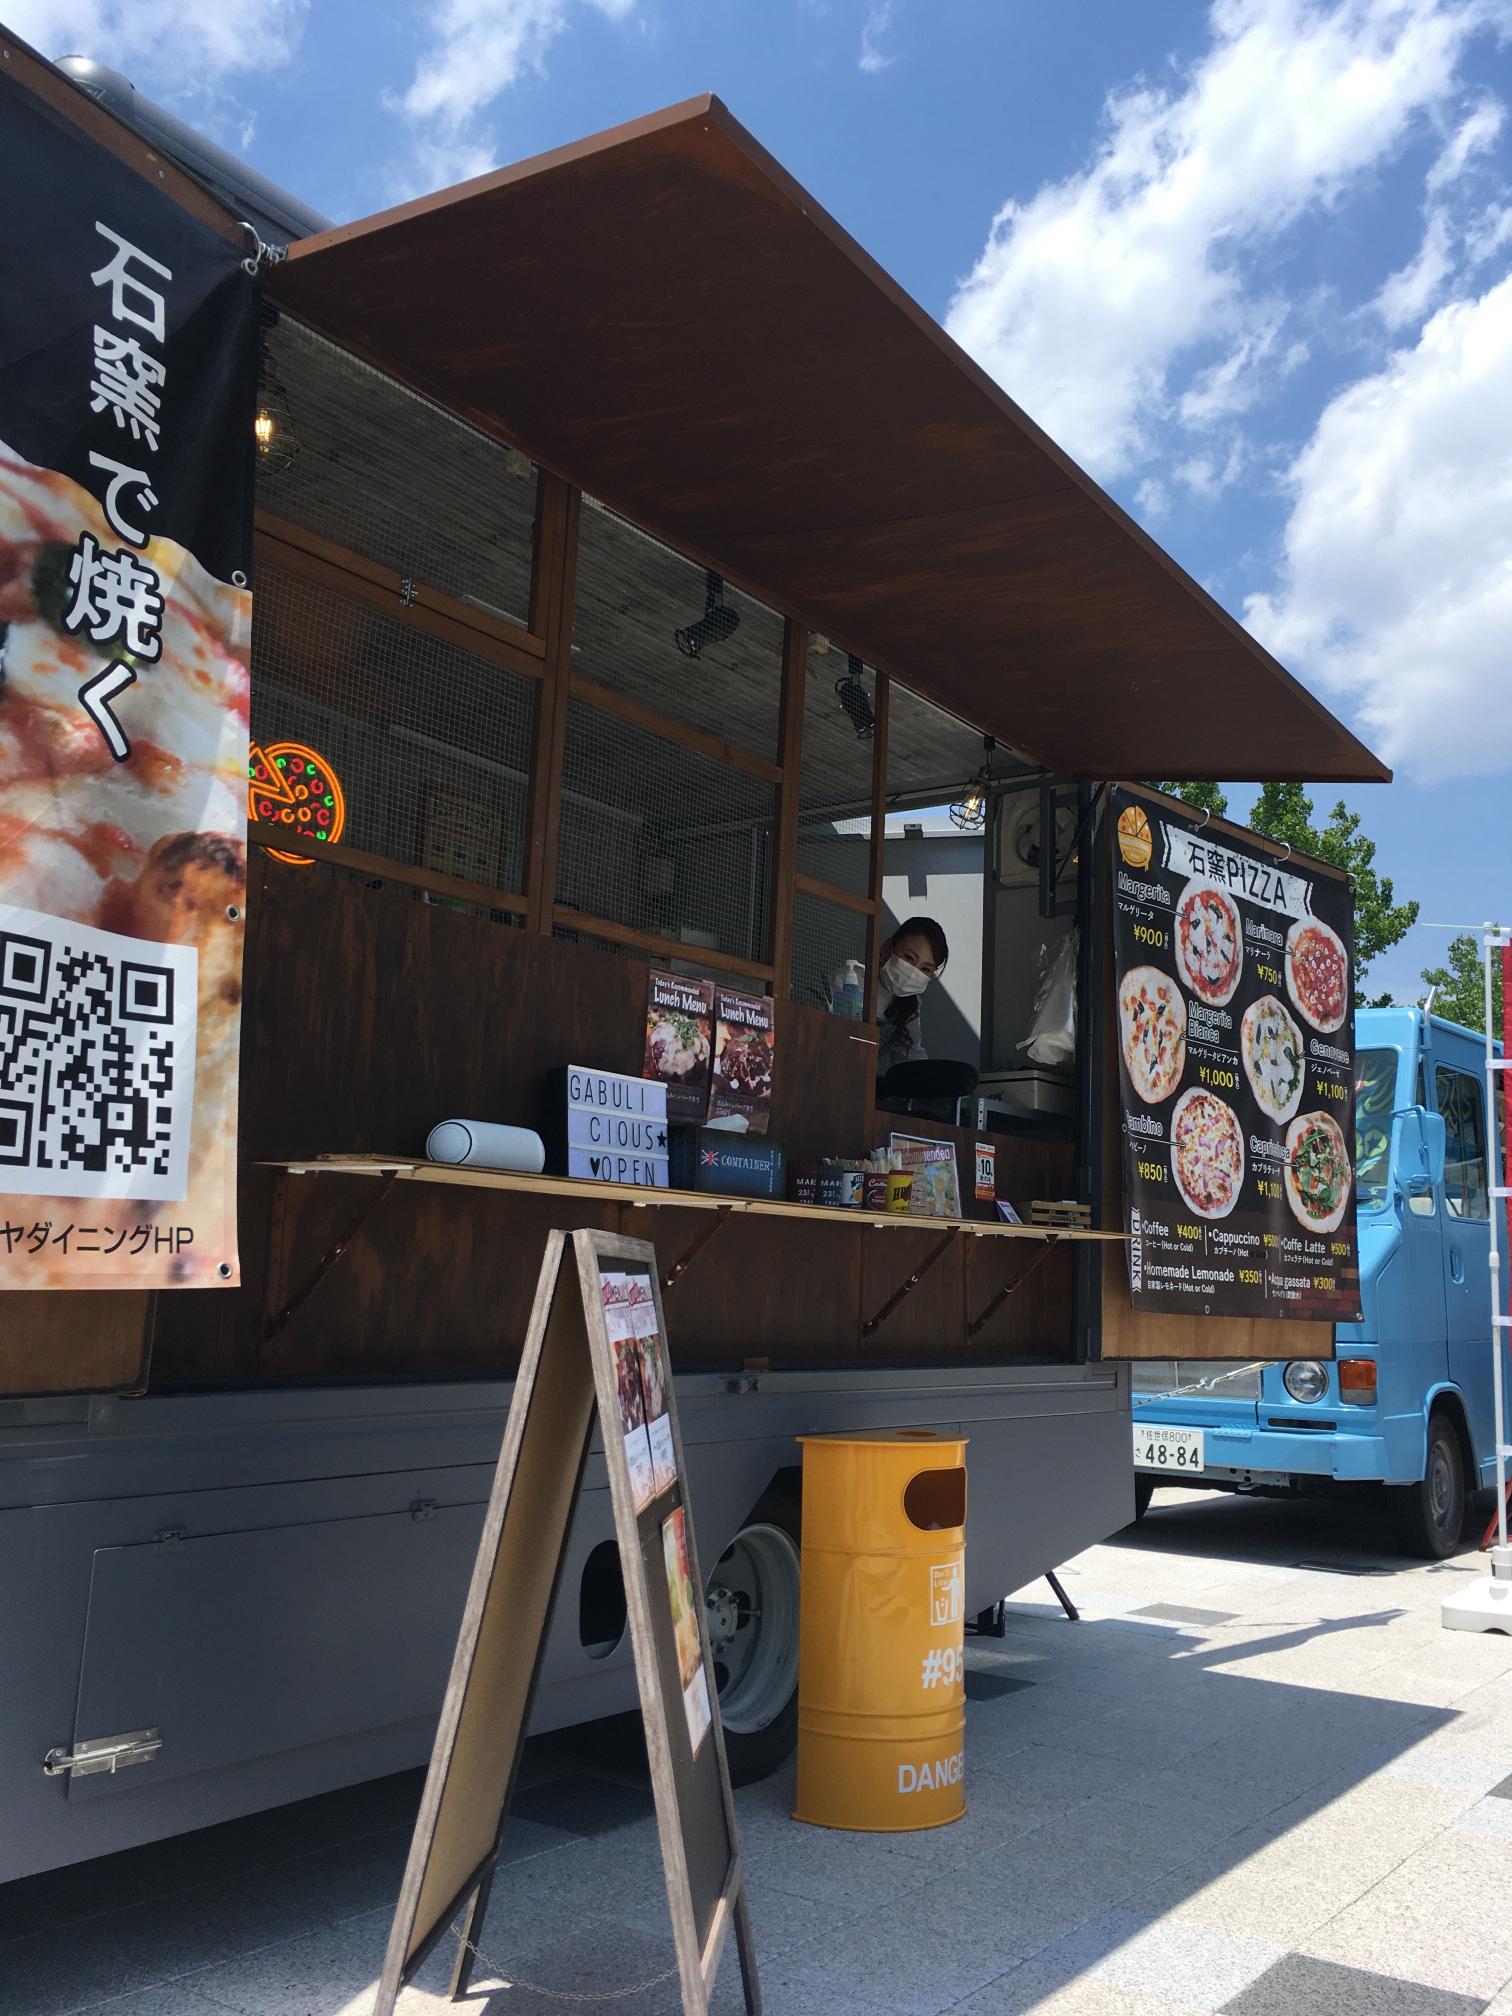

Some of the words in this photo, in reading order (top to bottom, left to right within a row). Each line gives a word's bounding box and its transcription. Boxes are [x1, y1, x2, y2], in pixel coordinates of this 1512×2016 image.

[66, 220, 173, 763] 石窯で焼く
[1187, 841, 1287, 909] 石窯PIZZA
[1117, 870, 1171, 905] Margerita
[1118, 902, 1154, 921] マルゲリータ
[1133, 924, 1163, 947] ¥900
[1256, 963, 1278, 985] ¥750
[654, 986, 680, 1007] Lunch
[682, 994, 707, 1014] Menu
[720, 1002, 745, 1022] Lunch
[746, 1009, 769, 1028] Menu
[1188, 1000, 1233, 1029] Margerita
[1188, 1018, 1220, 1043] Bianca
[1199, 1066, 1234, 1088] ¥1,000
[570, 1074, 645, 1111] GABULI
[1316, 1080, 1344, 1100] ¥1,100
[590, 1116, 654, 1150] CIOUS
[602, 1155, 656, 1187] OPEN
[721, 1154, 770, 1172] CONTAINER
[1138, 1161, 1163, 1182] ¥850
[0, 1221, 195, 1255] ヤダイニングHP
[1143, 1220, 1169, 1237] Coffee
[1176, 1224, 1199, 1240] ¥400
[1212, 1228, 1260, 1246] Cappuccino
[1132, 1219, 1142, 1280] DRINK
[1283, 1237, 1303, 1251] Coffe
[1304, 1240, 1326, 1253] Latte
[1330, 1242, 1347, 1256] ¥500
[1146, 1260, 1190, 1279] Homemade
[1191, 1265, 1235, 1282] Lemonade
[1239, 1269, 1258, 1284] ¥350
[1284, 1277, 1311, 1290] gassata
[1313, 1276, 1333, 1290] ¥300
[1145, 1443, 1199, 1468] 48-84
